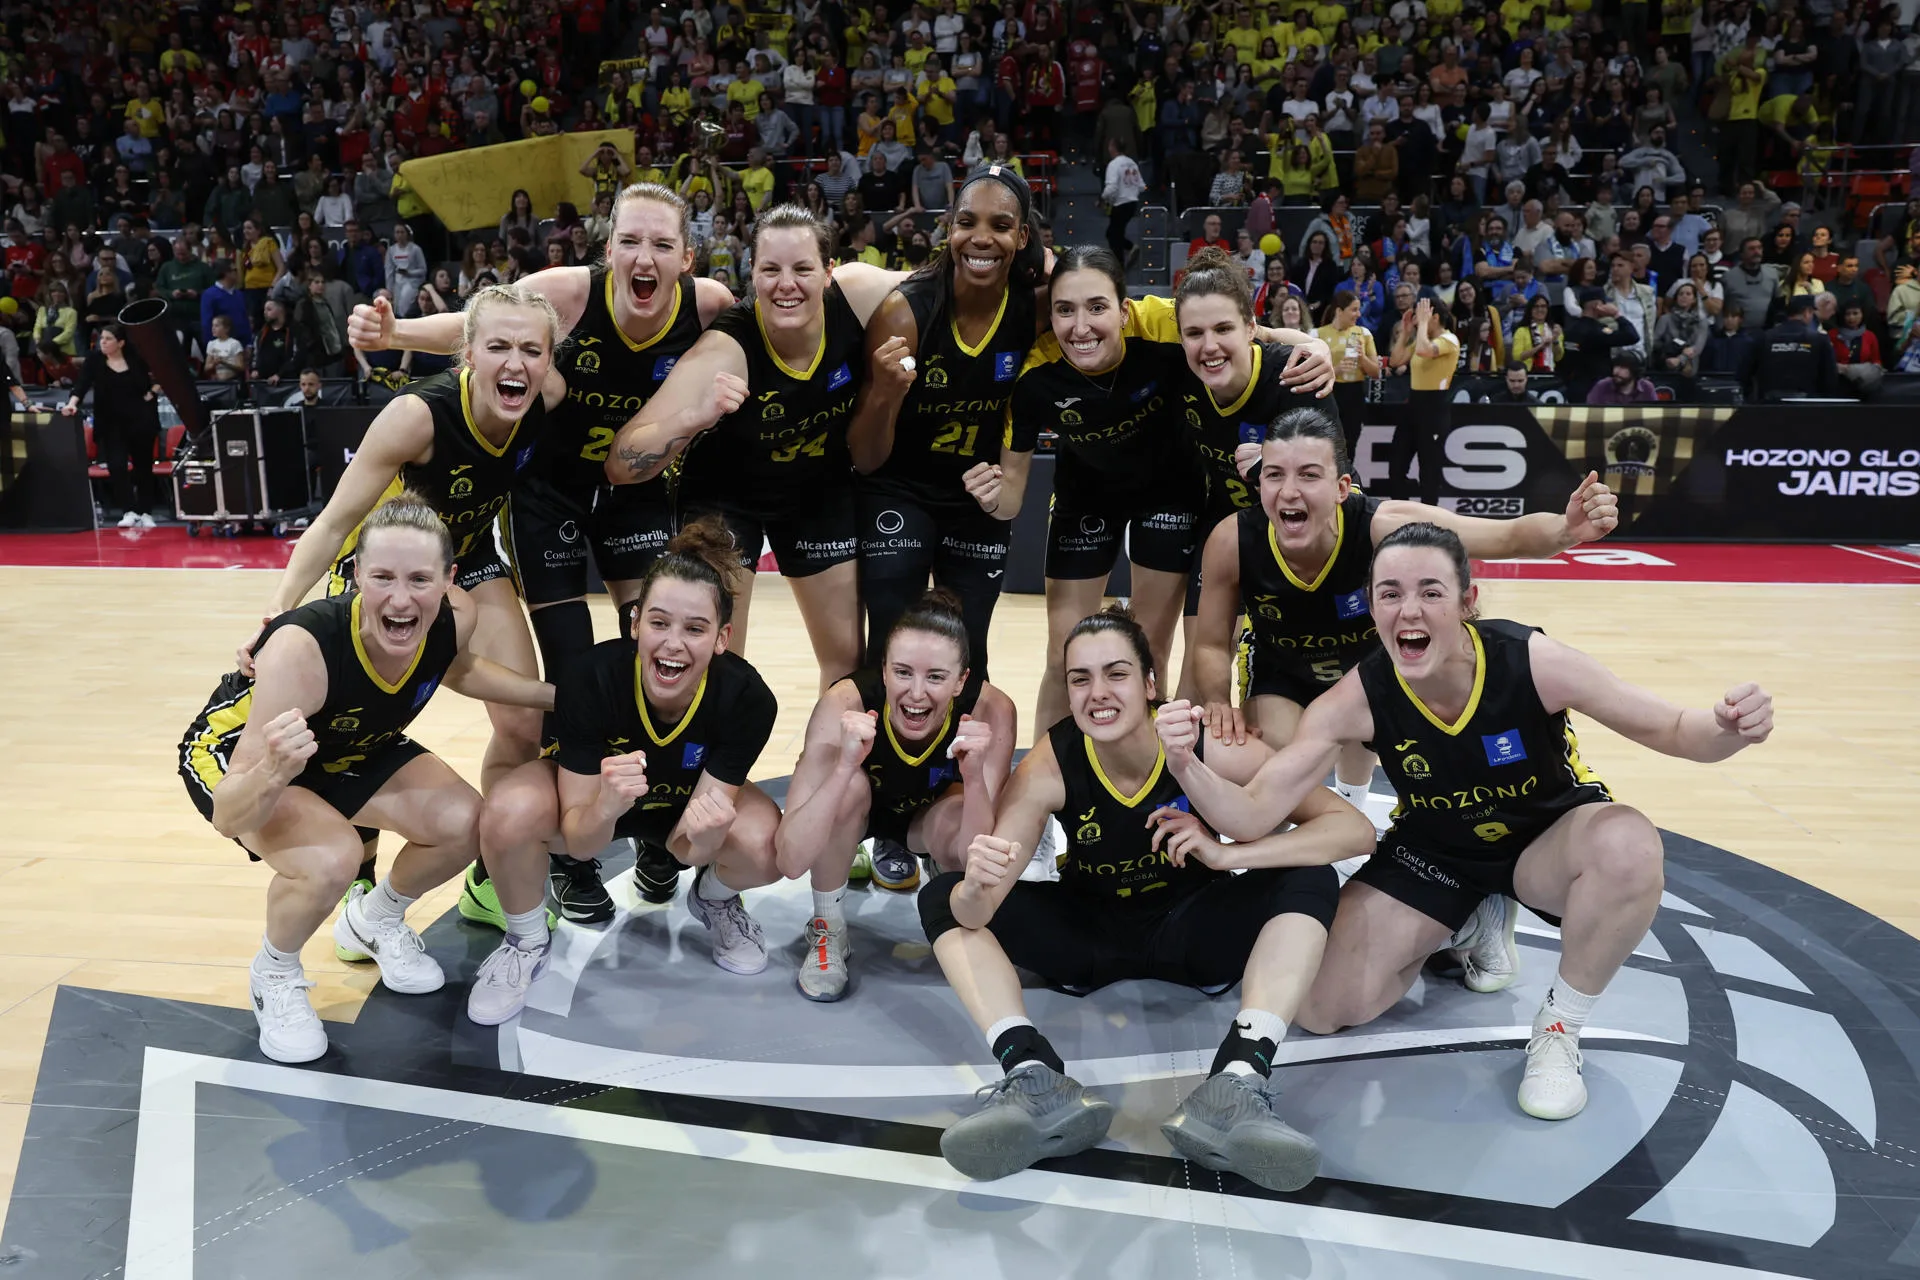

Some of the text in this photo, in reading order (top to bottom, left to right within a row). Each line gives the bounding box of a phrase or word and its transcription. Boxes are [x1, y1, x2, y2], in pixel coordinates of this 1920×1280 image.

[568, 387, 650, 410] HOZO
[918, 399, 1009, 414] HOZON
[760, 393, 857, 440] HOZON
[930, 421, 980, 457] 21
[1726, 449, 1851, 467] HOZONO
[1778, 471, 1920, 496] JAIRIS
[1456, 499, 1521, 515] 2025
[544, 550, 571, 560] Costa
[861, 540, 886, 550] Costa
[942, 536, 1007, 555] Alcantarilla
[1311, 659, 1343, 682] 5
[1410, 775, 1538, 809] HOZONO
[1078, 850, 1172, 876] HOZON
[1396, 845, 1426, 869] Costa
